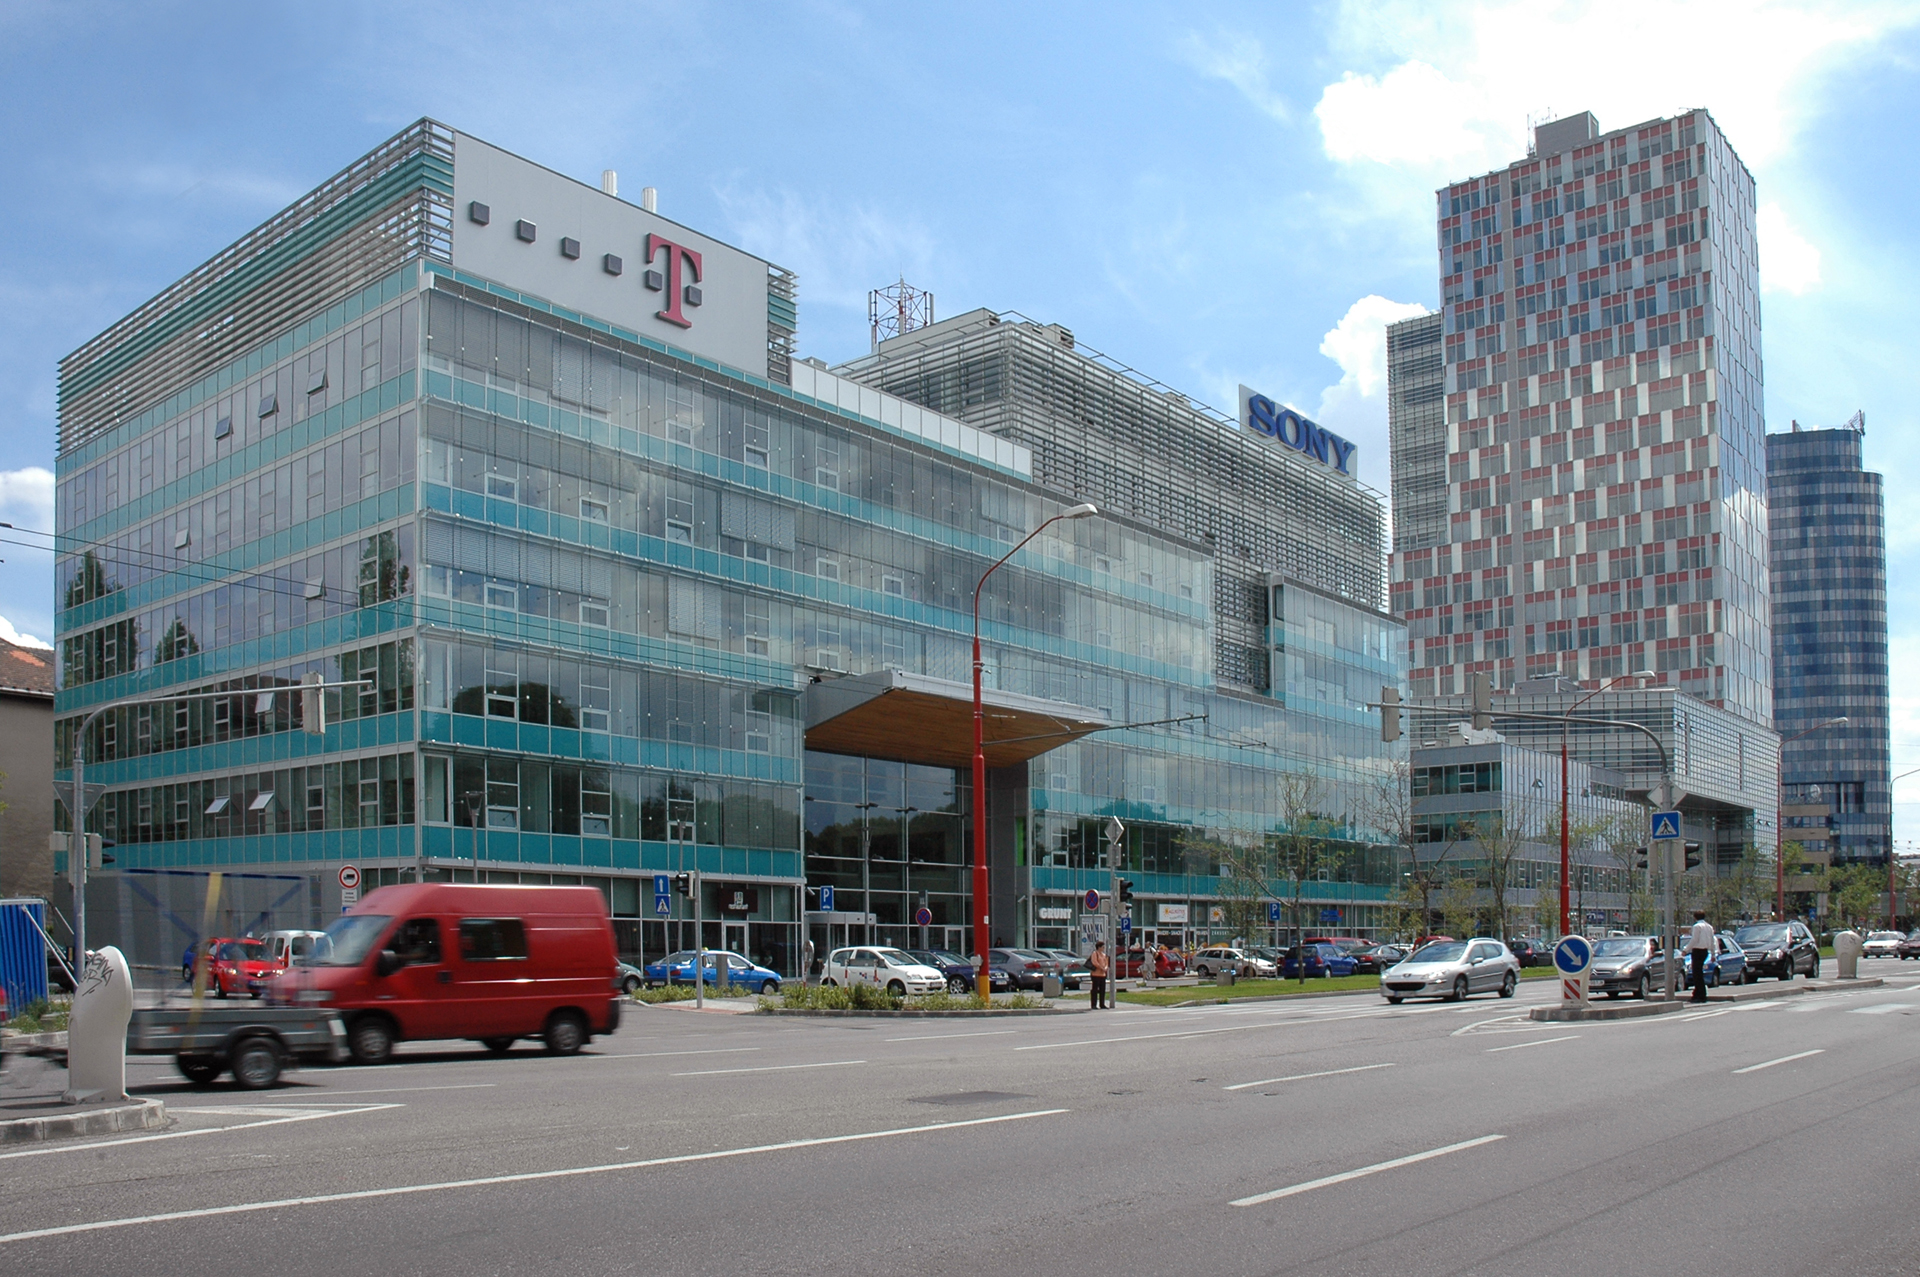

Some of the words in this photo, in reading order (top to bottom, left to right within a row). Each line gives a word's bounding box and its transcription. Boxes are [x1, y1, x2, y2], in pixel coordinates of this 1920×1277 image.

[646, 232, 703, 329] T
[1248, 393, 1356, 475] SONY
[824, 888, 830, 902] P
[1038, 907, 1073, 919] GRUNT
[1123, 918, 1129, 929] P
